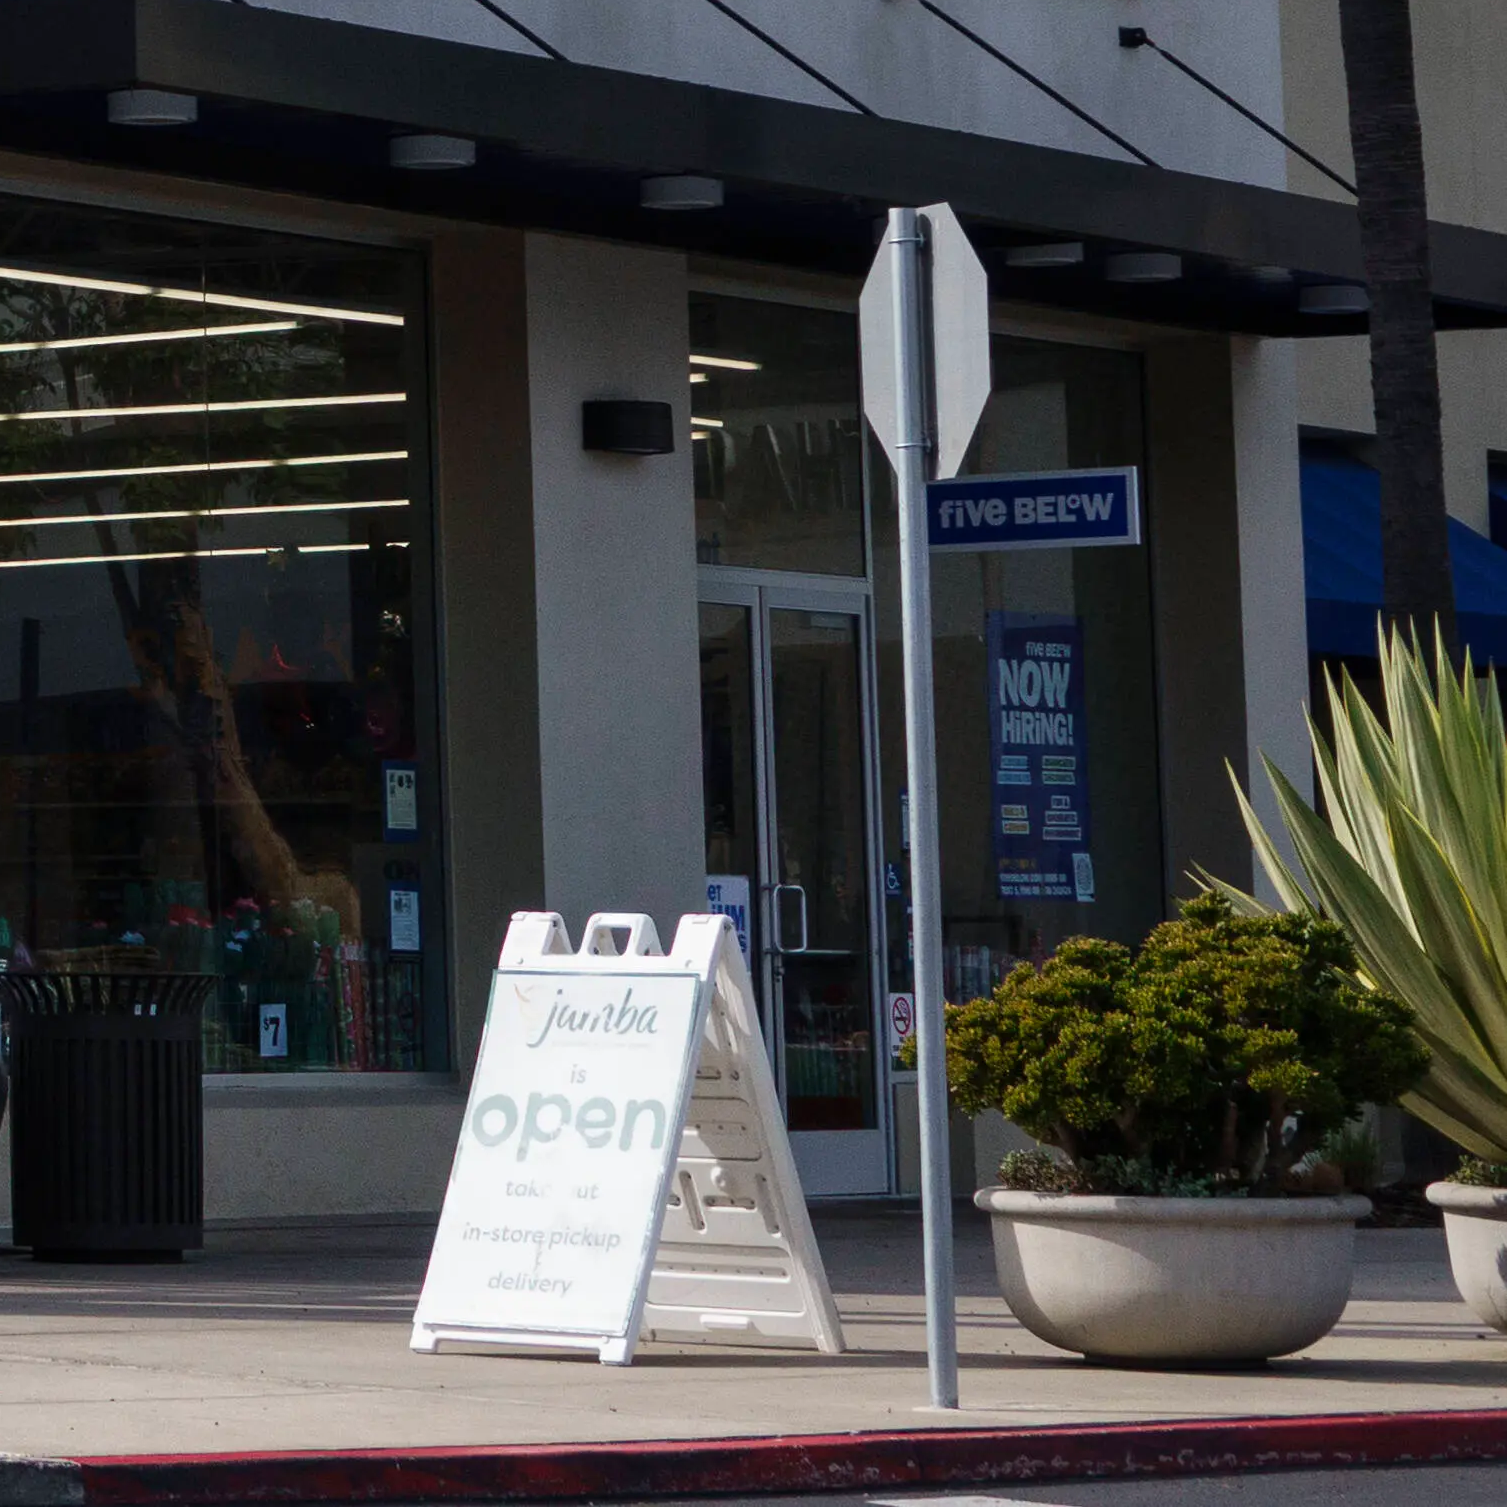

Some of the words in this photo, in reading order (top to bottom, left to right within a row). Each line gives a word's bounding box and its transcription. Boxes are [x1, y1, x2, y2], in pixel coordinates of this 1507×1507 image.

[938, 497, 1008, 529] five
[1013, 492, 1115, 525] BELOW
[997, 658, 1070, 708] NOW
[263, 1016, 281, 1047] $7
[526, 987, 659, 1049] jamba
[569, 1063, 588, 1085] is
[471, 1091, 667, 1163] open
[462, 1221, 546, 1245] in-store
[547, 1227, 622, 1250] pickup
[487, 1271, 573, 1298] delivery
